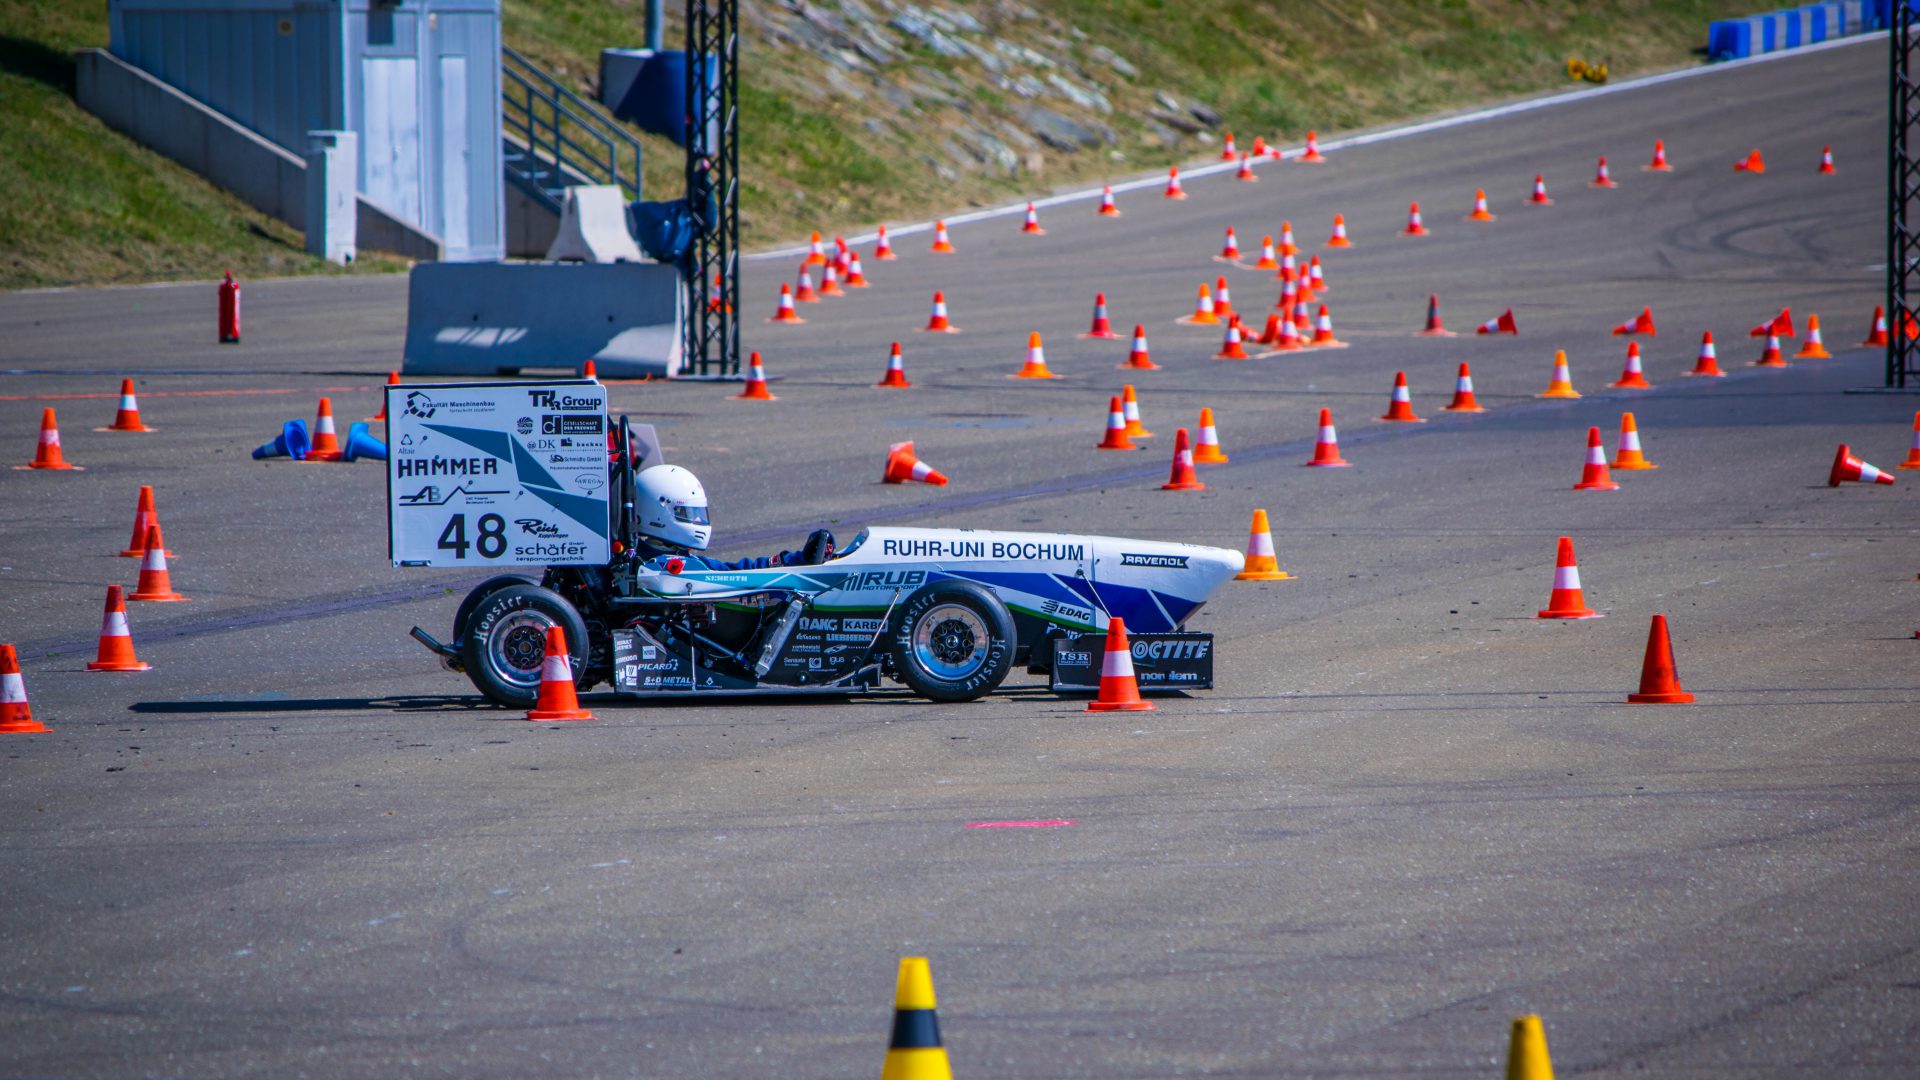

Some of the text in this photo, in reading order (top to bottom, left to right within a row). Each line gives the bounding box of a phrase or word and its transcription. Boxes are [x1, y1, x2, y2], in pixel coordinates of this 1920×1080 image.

[562, 396, 602, 410] Group
[538, 440, 556, 449] DK
[397, 458, 498, 479] HAMMER
[514, 518, 559, 535] Reich
[437, 513, 508, 559] 48
[515, 543, 588, 556] schäfer
[883, 540, 1084, 561] RUHR-UNI BOCHUM
[1125, 555, 1184, 567] RAVENOL
[863, 570, 926, 586] RUB
[1058, 606, 1091, 621] EDAG
[825, 633, 873, 642] LIEBHERR
[1128, 641, 1211, 660] OCTITE
